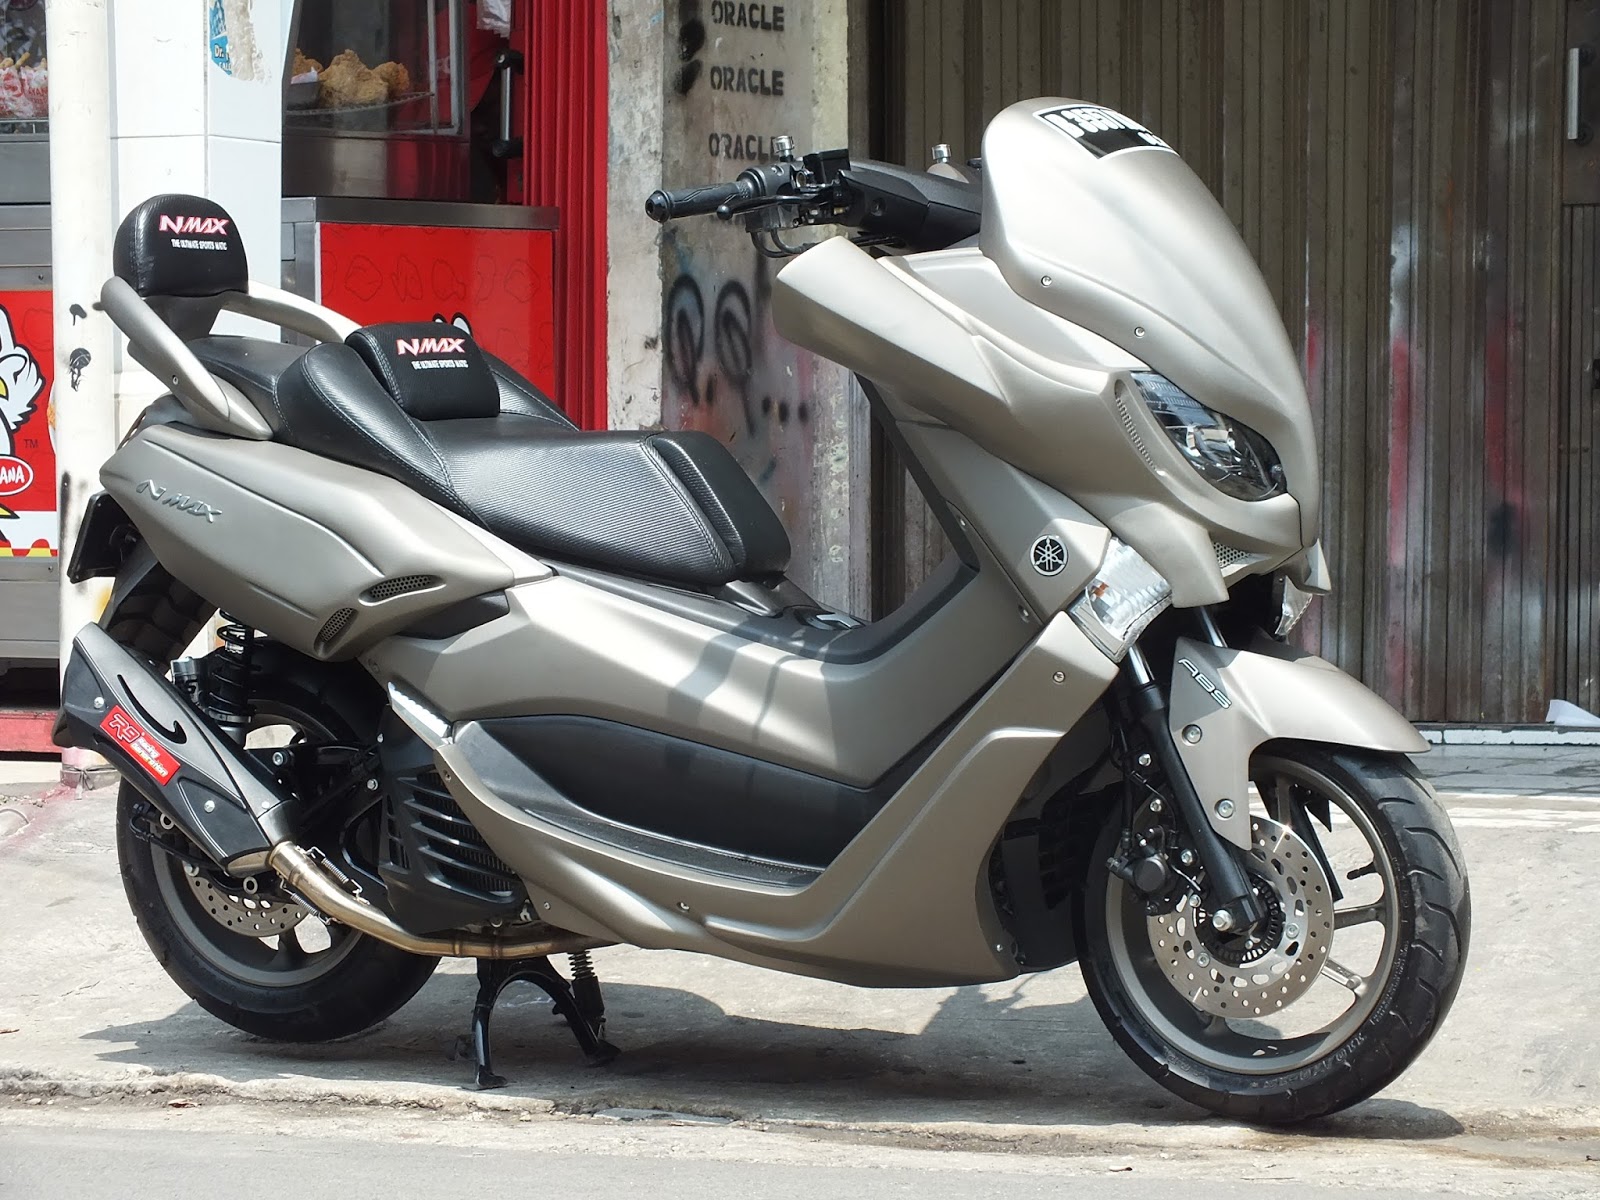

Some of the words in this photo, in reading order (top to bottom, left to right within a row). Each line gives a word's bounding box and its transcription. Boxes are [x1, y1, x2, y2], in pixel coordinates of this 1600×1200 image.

[711, 0, 784, 32] ORACLE
[710, 66, 784, 96] ORACLE
[1044, 113, 1085, 139] B
[159, 214, 229, 236] NMAX
[396, 337, 466, 357] NMAX
[1178, 658, 1232, 709] ABS
[109, 713, 141, 743] R9
